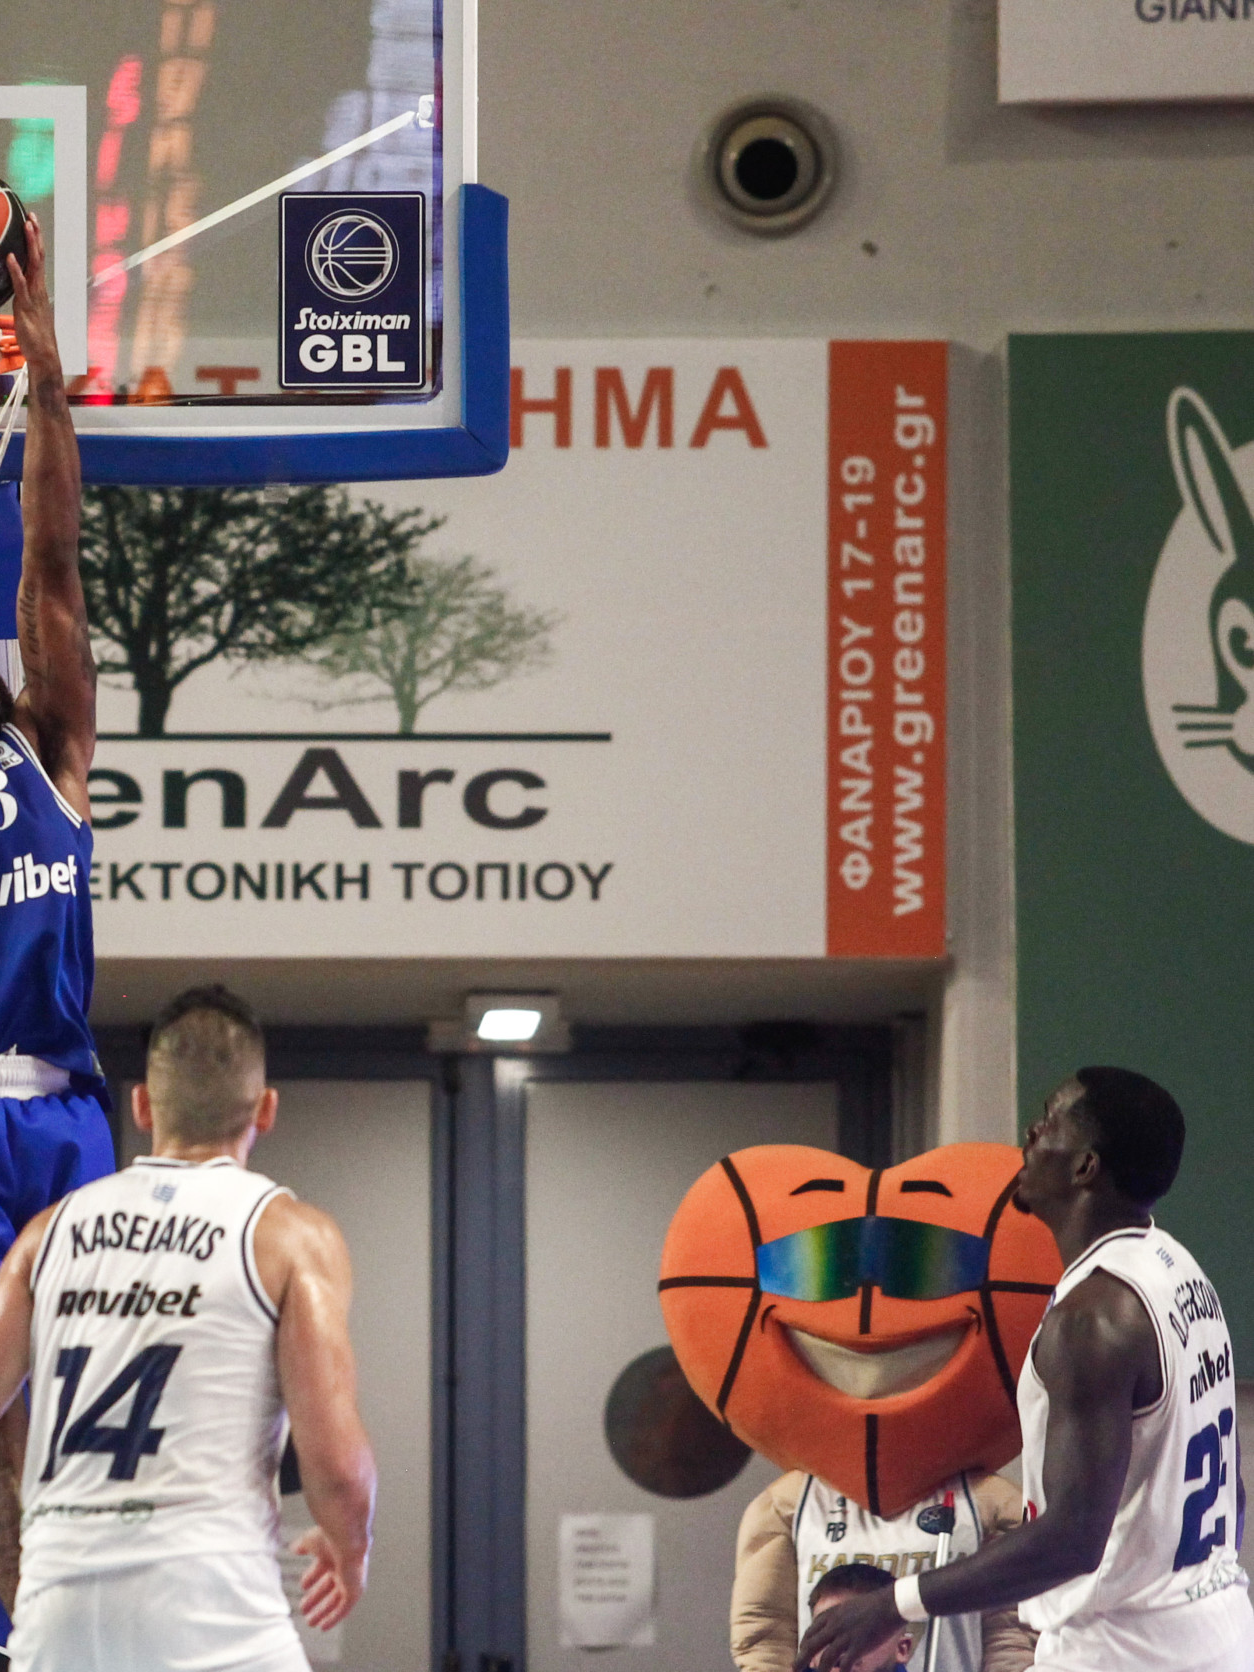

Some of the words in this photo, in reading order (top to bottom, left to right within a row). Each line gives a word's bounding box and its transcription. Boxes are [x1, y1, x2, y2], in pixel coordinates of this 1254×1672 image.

[294, 306, 411, 332] Stoiximan
[298, 334, 406, 373] GBL
[841, 455, 876, 597] 17-19
[893, 384, 937, 917] www.greenarc.gr
[840, 616, 875, 890] ΦΑΝΑΡΙΟΥ
[392, 861, 615, 901] ΤΟΠΙΟΥ
[57, 1280, 204, 1318] novibet
[39, 1344, 184, 1483] 14
